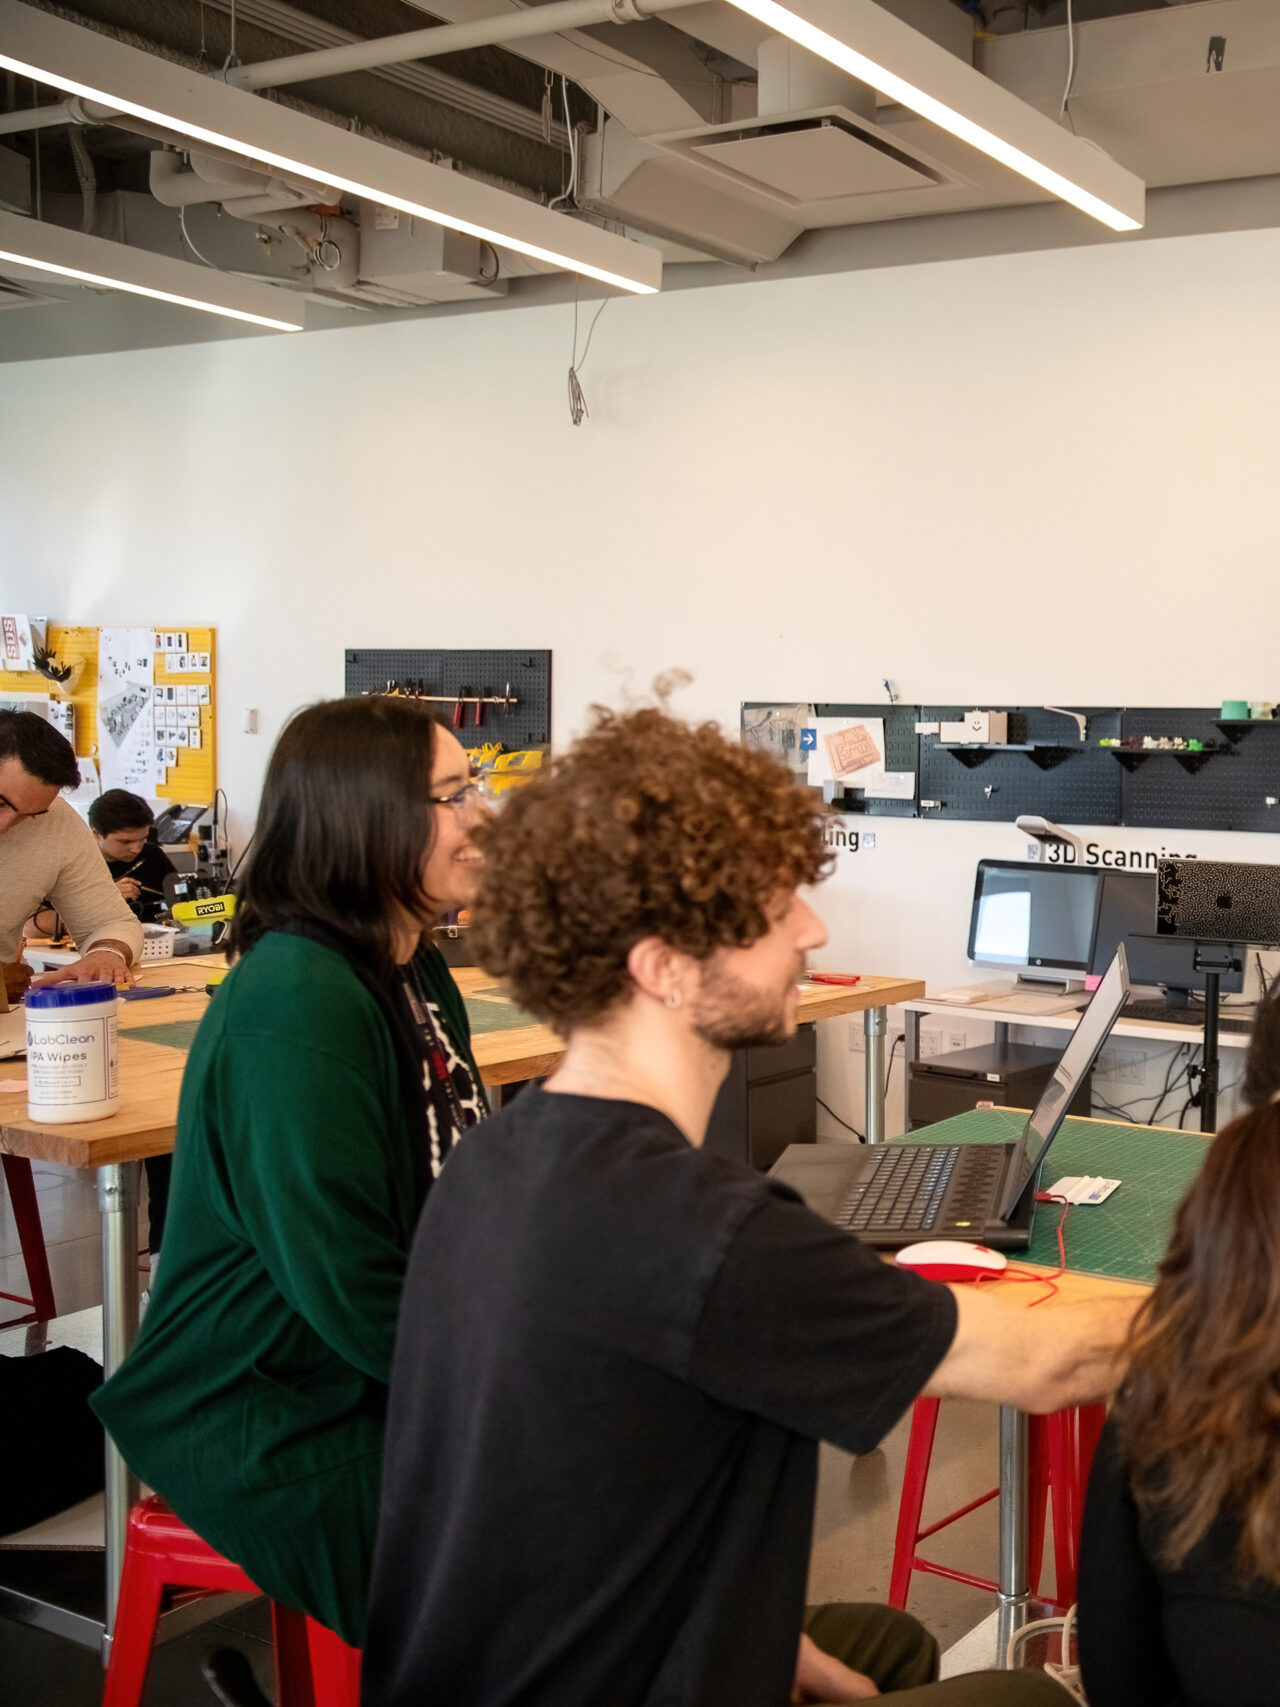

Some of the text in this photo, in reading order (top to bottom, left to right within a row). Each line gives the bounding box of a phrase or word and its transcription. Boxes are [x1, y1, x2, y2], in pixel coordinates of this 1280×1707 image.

[3, 619, 17, 659] SDS
[1048, 843, 1197, 869] 3D Scanni
[197, 903, 224, 915] RYOBI
[34, 1034, 95, 1045] LabClean
[47, 1053, 87, 1063] Wipes
